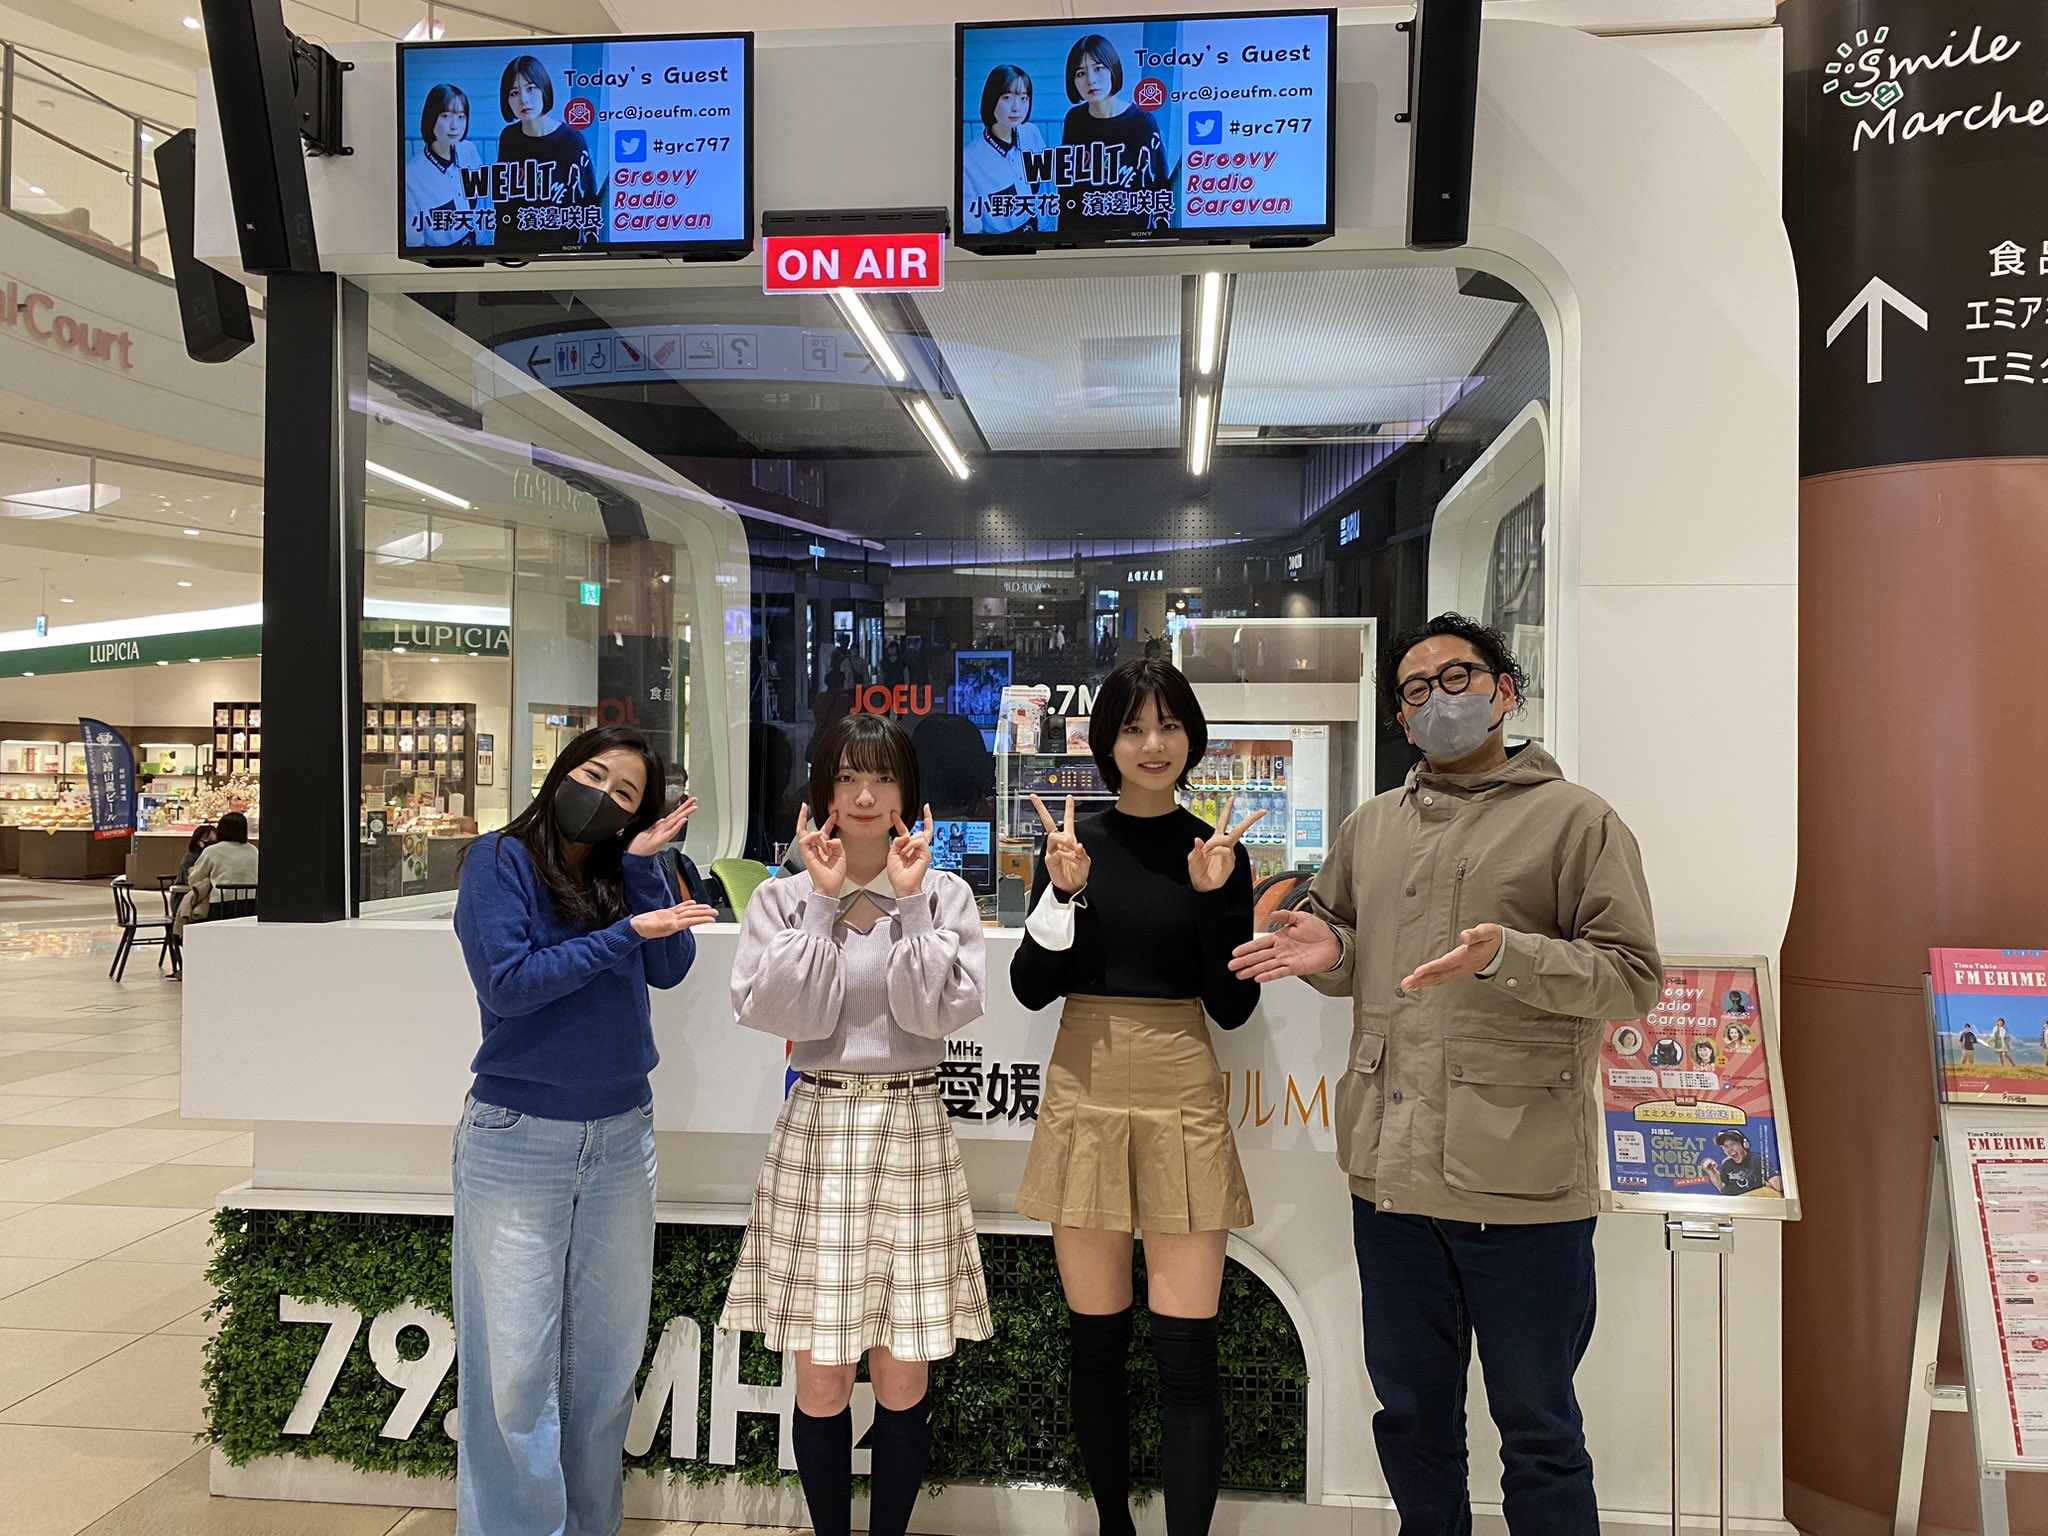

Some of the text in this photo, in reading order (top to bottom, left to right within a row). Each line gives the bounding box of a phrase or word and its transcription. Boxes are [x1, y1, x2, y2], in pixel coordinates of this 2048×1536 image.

[1134, 45, 1311, 67] Today's Guest
[1853, 25, 2022, 88] Smile
[564, 66, 728, 88] Today's Guest
[1171, 85, 1312, 102] grc@joeufm.com
[599, 105, 730, 122] grc@joeufm.com
[1229, 118, 1312, 137] #grc797
[653, 137, 730, 155] #grc797
[1187, 150, 1277, 171] Groovy
[614, 168, 697, 188] Groovy
[1186, 174, 1255, 194] Radio
[614, 191, 677, 209] Radio
[1186, 196, 1292, 216] Caravan
[614, 212, 712, 231] Caravan
[777, 247, 927, 281] ON AIR
[1989, 239, 2048, 277] 食
[1966, 297, 2048, 329] エミア
[24, 293, 133, 369] Court
[394, 624, 510, 650] LUPICIA
[90, 641, 140, 663] LUPICIA
[1954, 970, 2047, 987] FM EHIME
[1661, 987, 1704, 1001] oovy
[1655, 1001, 1691, 1012] adio
[1646, 1013, 1718, 1028] Caravan
[935, 1062, 1040, 1121] 愛媛
[1651, 1136, 1706, 1151] GREAT
[1968, 1138, 2046, 1150] FM EHIME
[1651, 1150, 1700, 1163] NOISY
[1654, 1164, 1704, 1178] CLUB!
